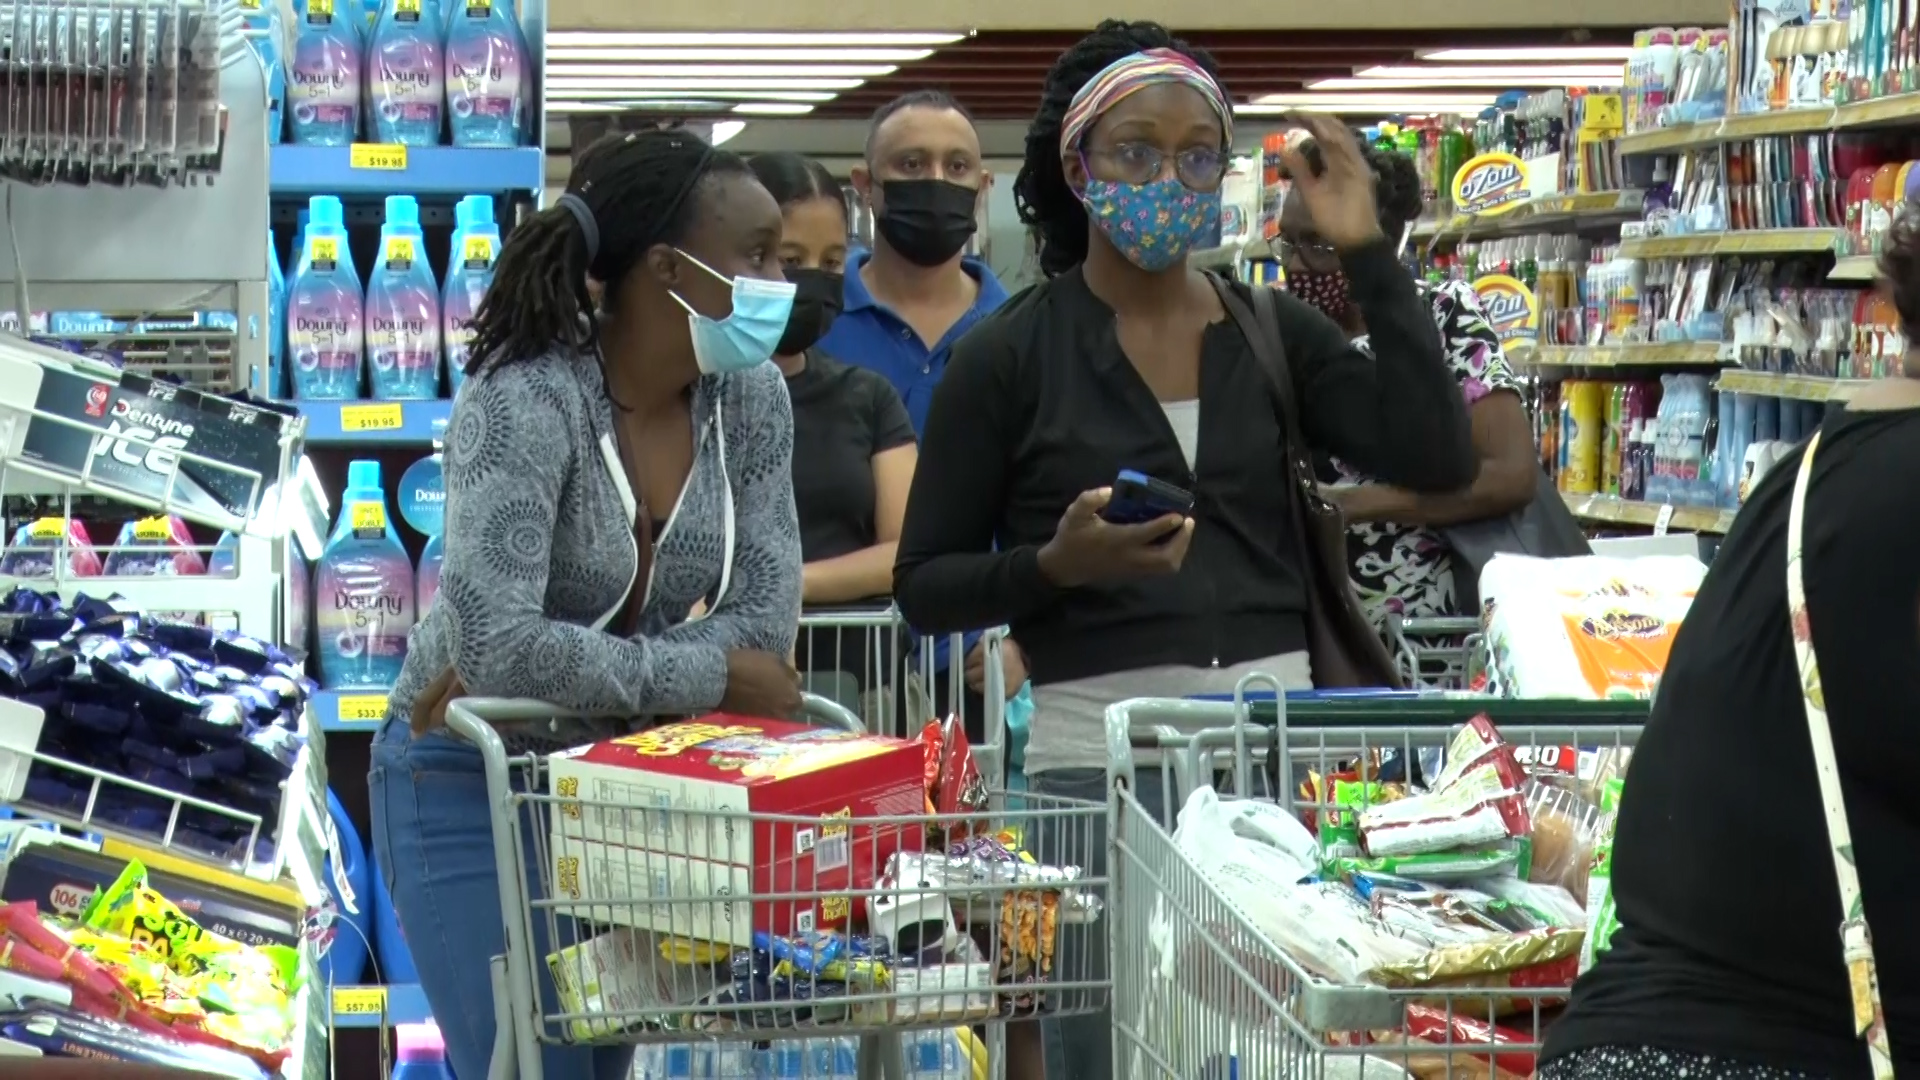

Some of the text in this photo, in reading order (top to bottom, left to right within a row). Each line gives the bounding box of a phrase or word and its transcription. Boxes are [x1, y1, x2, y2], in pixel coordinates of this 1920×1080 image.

[296, 317, 348, 336] Downy
[372, 317, 425, 336] Downy
[111, 397, 195, 437] Dentyne
[335, 591, 404, 616] Downy
[357, 709, 386, 719] $33.9
[55, 889, 77, 908] 106
